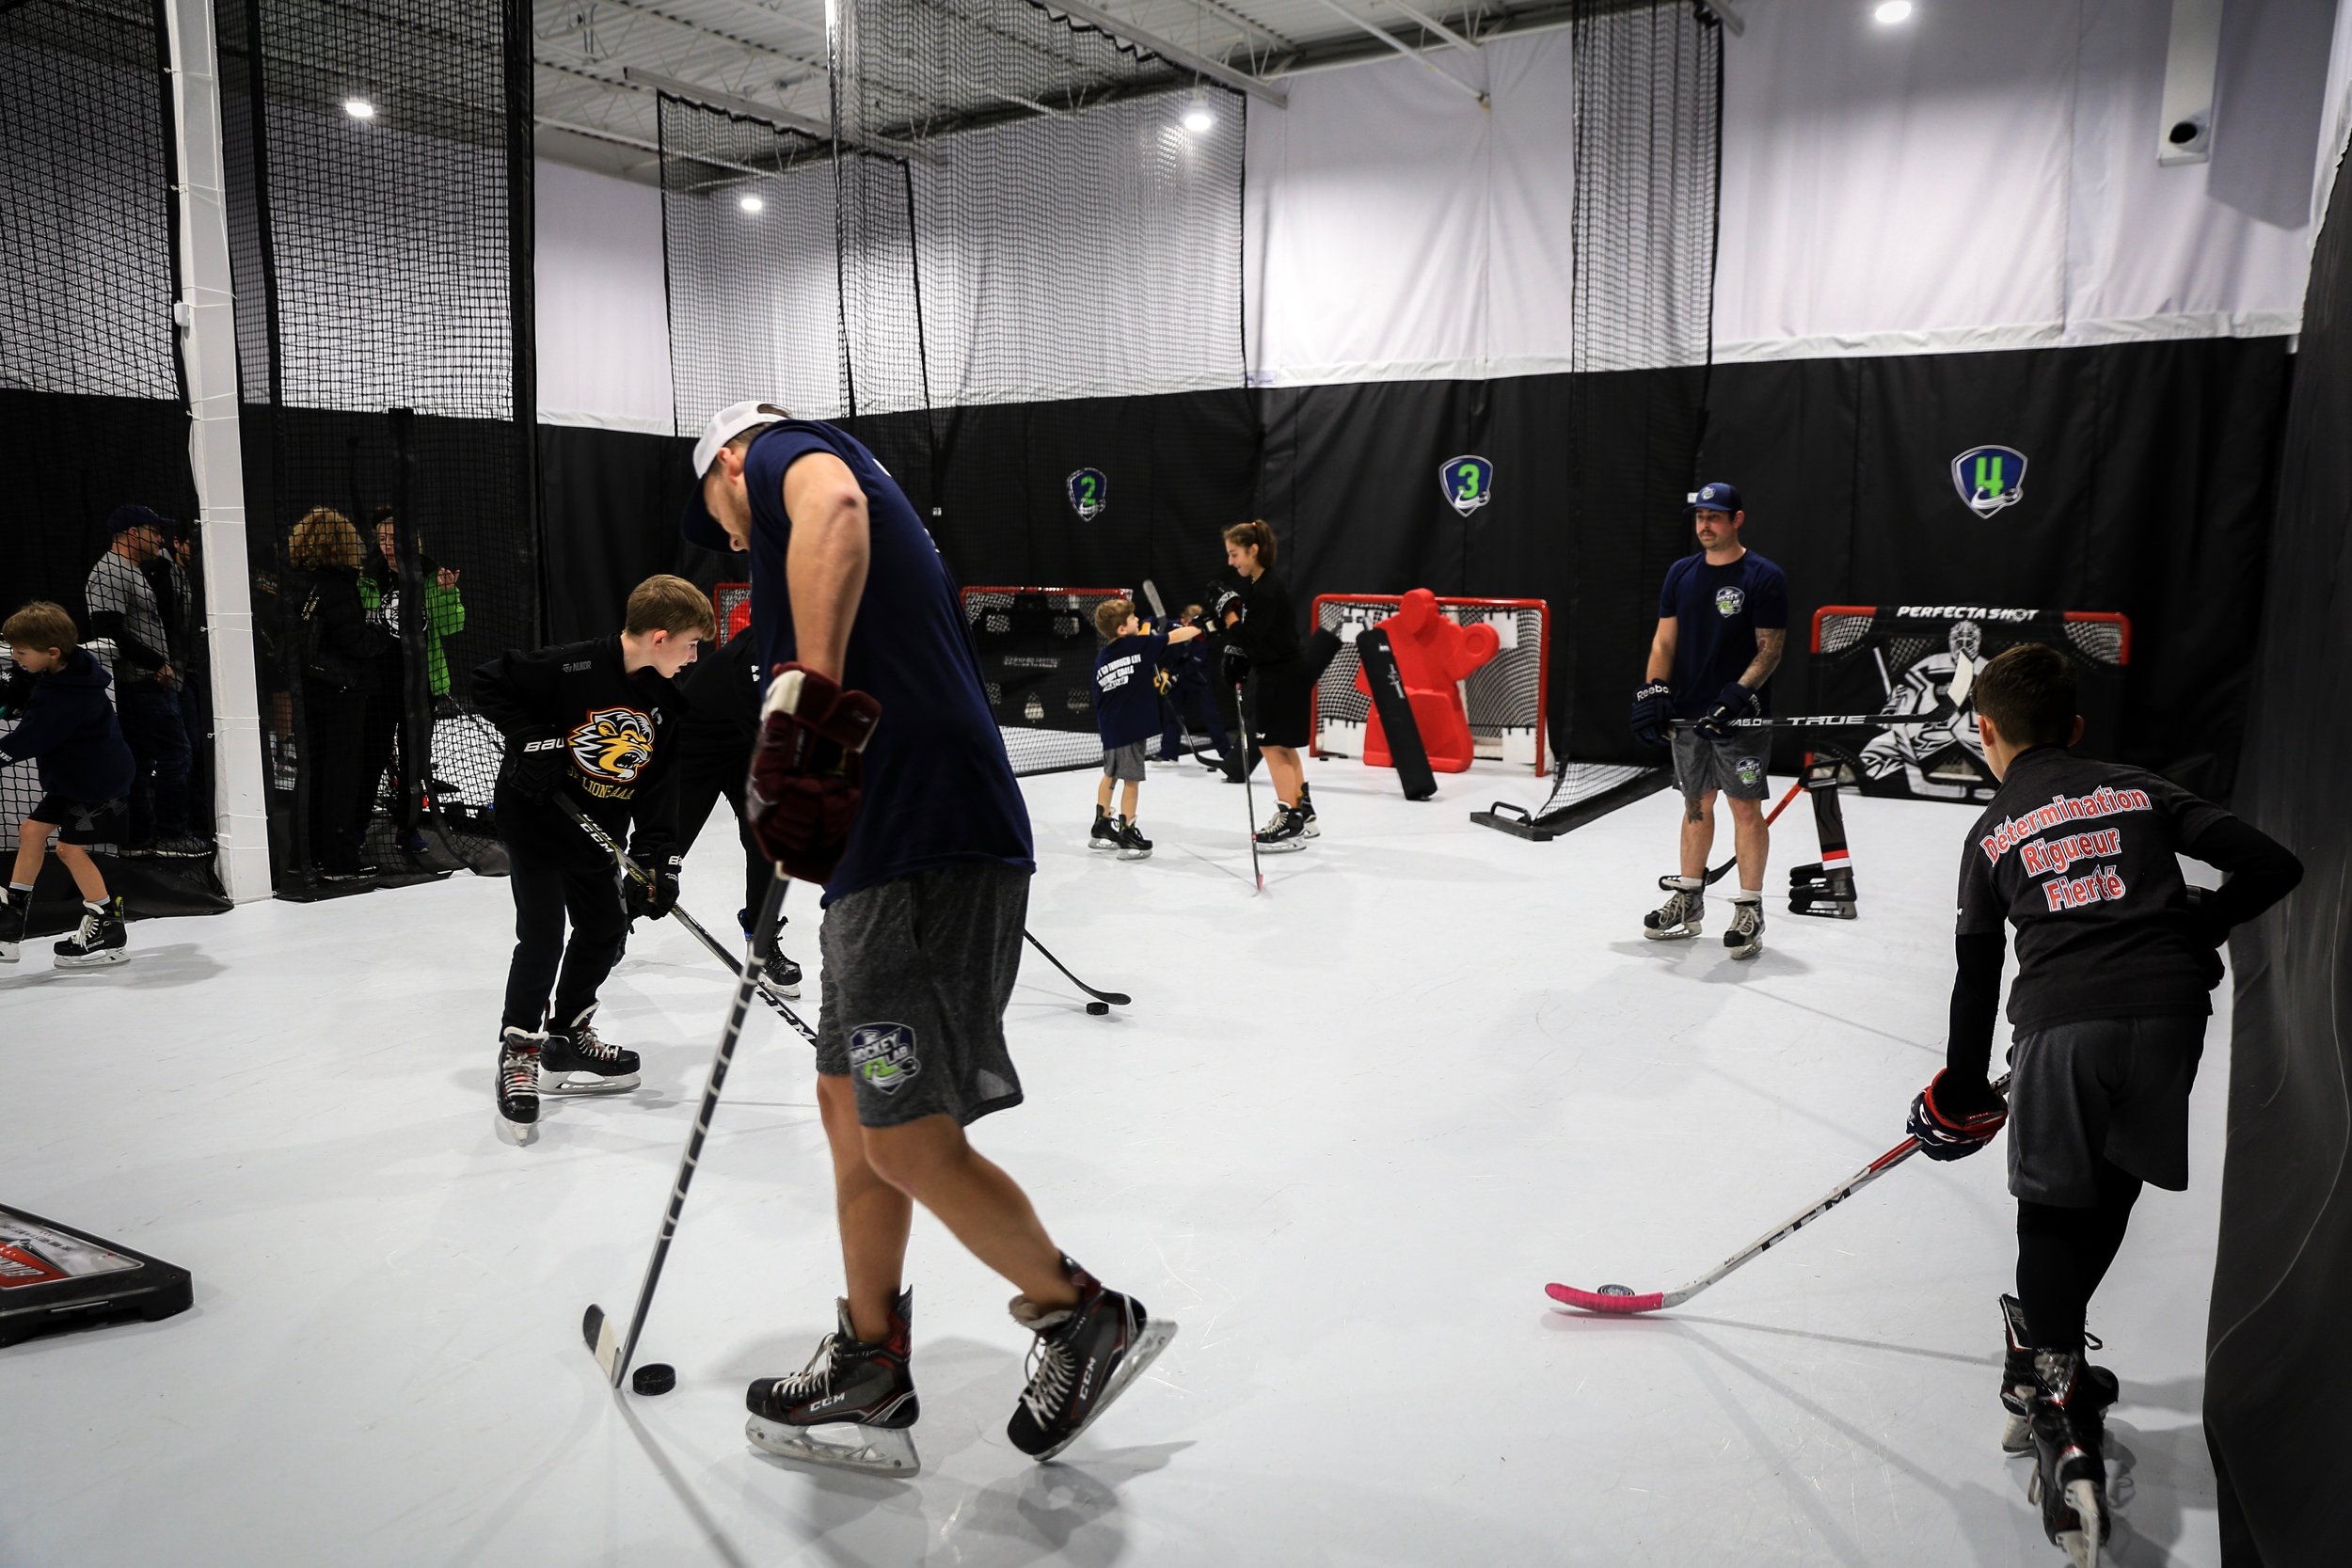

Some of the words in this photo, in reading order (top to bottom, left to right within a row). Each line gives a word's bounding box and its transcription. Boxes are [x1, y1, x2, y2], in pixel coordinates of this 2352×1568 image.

[1080, 476, 1096, 505] 2
[1457, 463, 1480, 499] 3
[1976, 456, 2004, 498] 4
[1107, 656, 1132, 672] THROUGH
[1117, 665, 1134, 677] GOALS
[1636, 685, 1670, 702] Reebo
[1788, 715, 1867, 726] TRUE
[523, 737, 565, 752] BAU
[580, 822, 614, 853] CCM
[1979, 784, 2153, 868] Détermination
[2020, 828, 2122, 879] Rigueur
[2042, 863, 2126, 912] Fierté
[850, 1033, 898, 1064] HOCKEY
[885, 1045, 910, 1066] LAB
[1079, 1356, 1097, 1401] CCM
[809, 1392, 846, 1412] CCM
